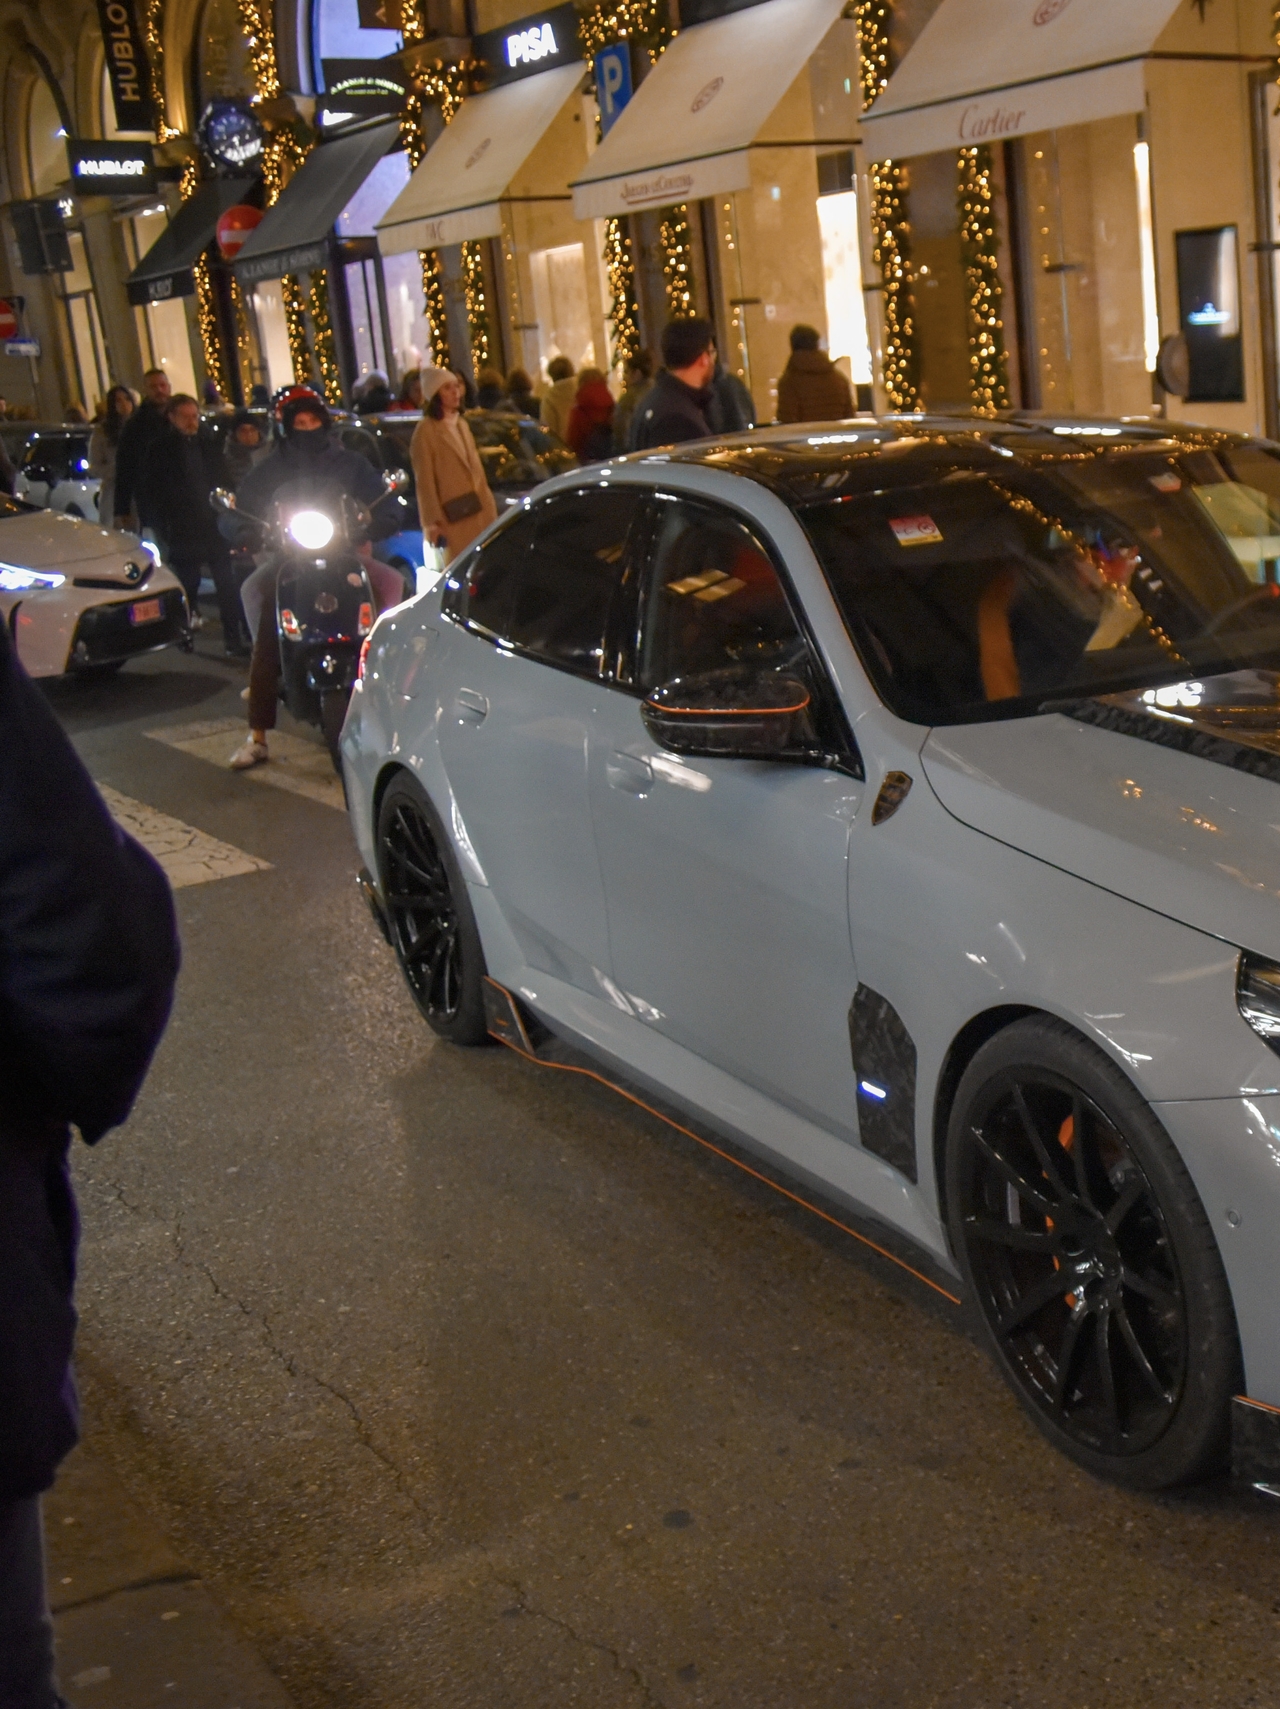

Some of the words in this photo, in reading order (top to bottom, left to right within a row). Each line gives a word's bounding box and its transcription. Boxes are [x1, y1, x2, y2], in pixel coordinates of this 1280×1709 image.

[106, 0, 140, 101] HUBLO
[507, 23, 557, 67] PISA
[601, 55, 623, 115] P
[958, 103, 1026, 140] Cartier
[79, 160, 146, 175] HUBLOT
